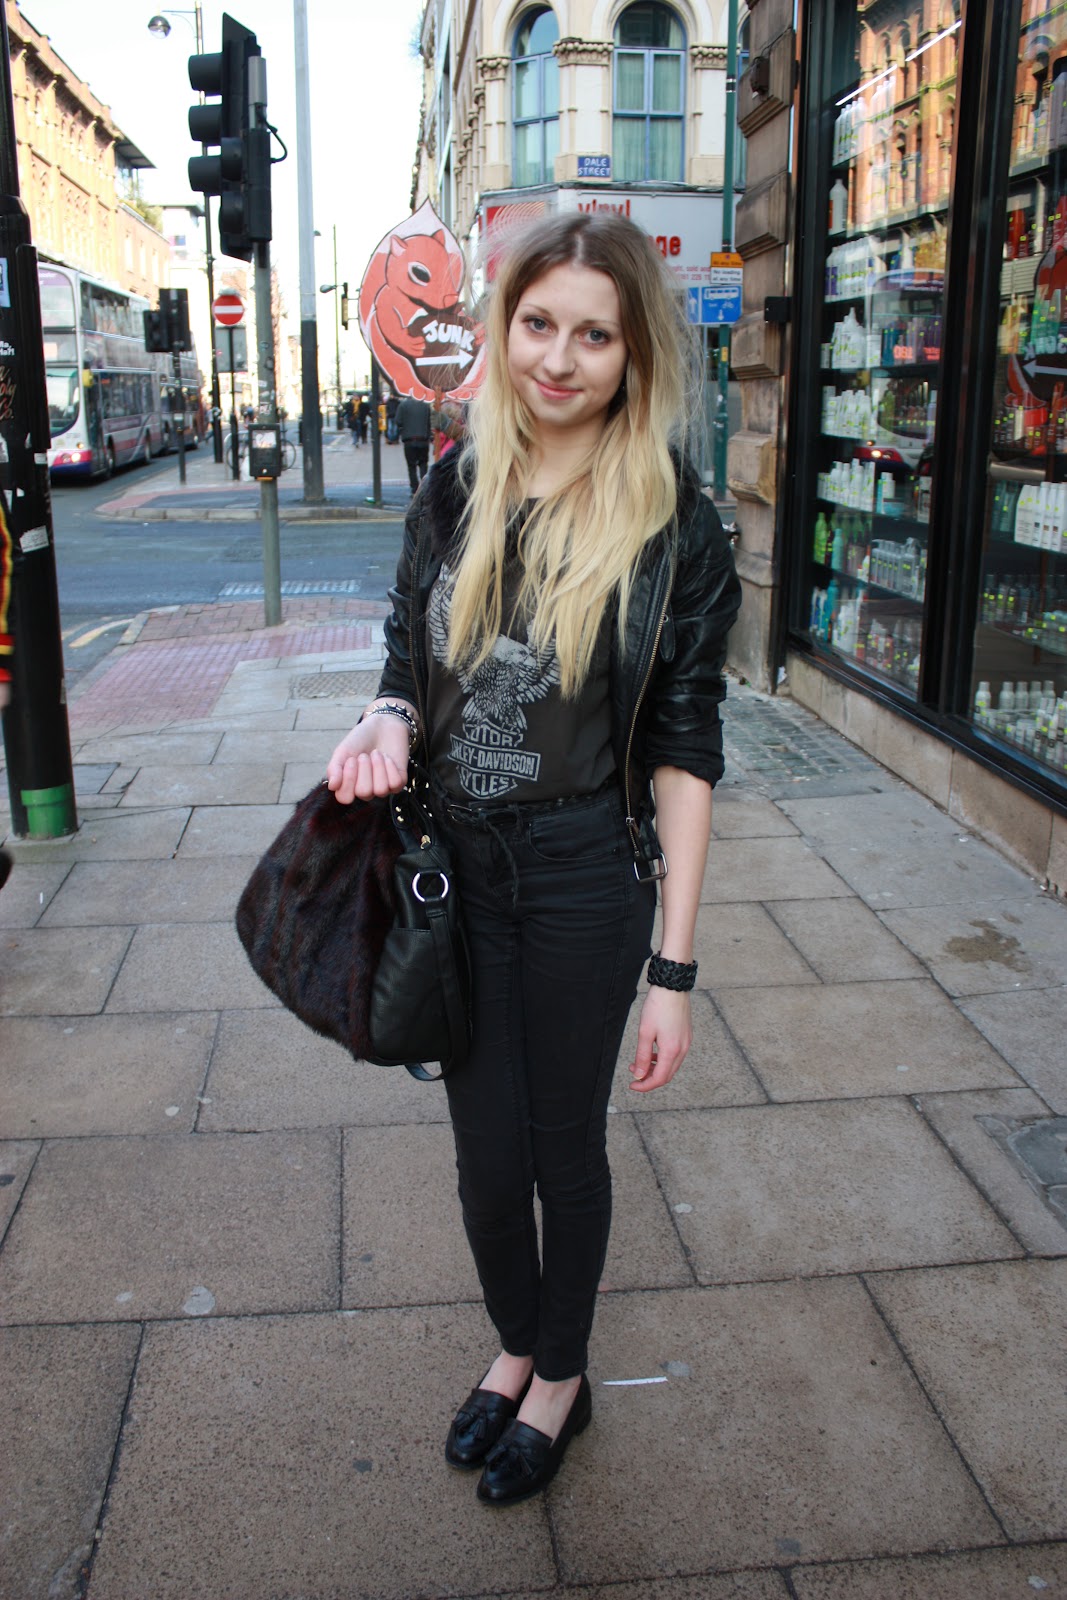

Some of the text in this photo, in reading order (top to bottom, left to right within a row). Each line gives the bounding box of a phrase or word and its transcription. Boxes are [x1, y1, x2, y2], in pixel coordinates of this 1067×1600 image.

[578, 167, 611, 176] STREET
[584, 157, 607, 167] DALE
[422, 319, 476, 352] JUNK
[470, 723, 514, 747] OTOR
[461, 765, 510, 796] CYCLES
